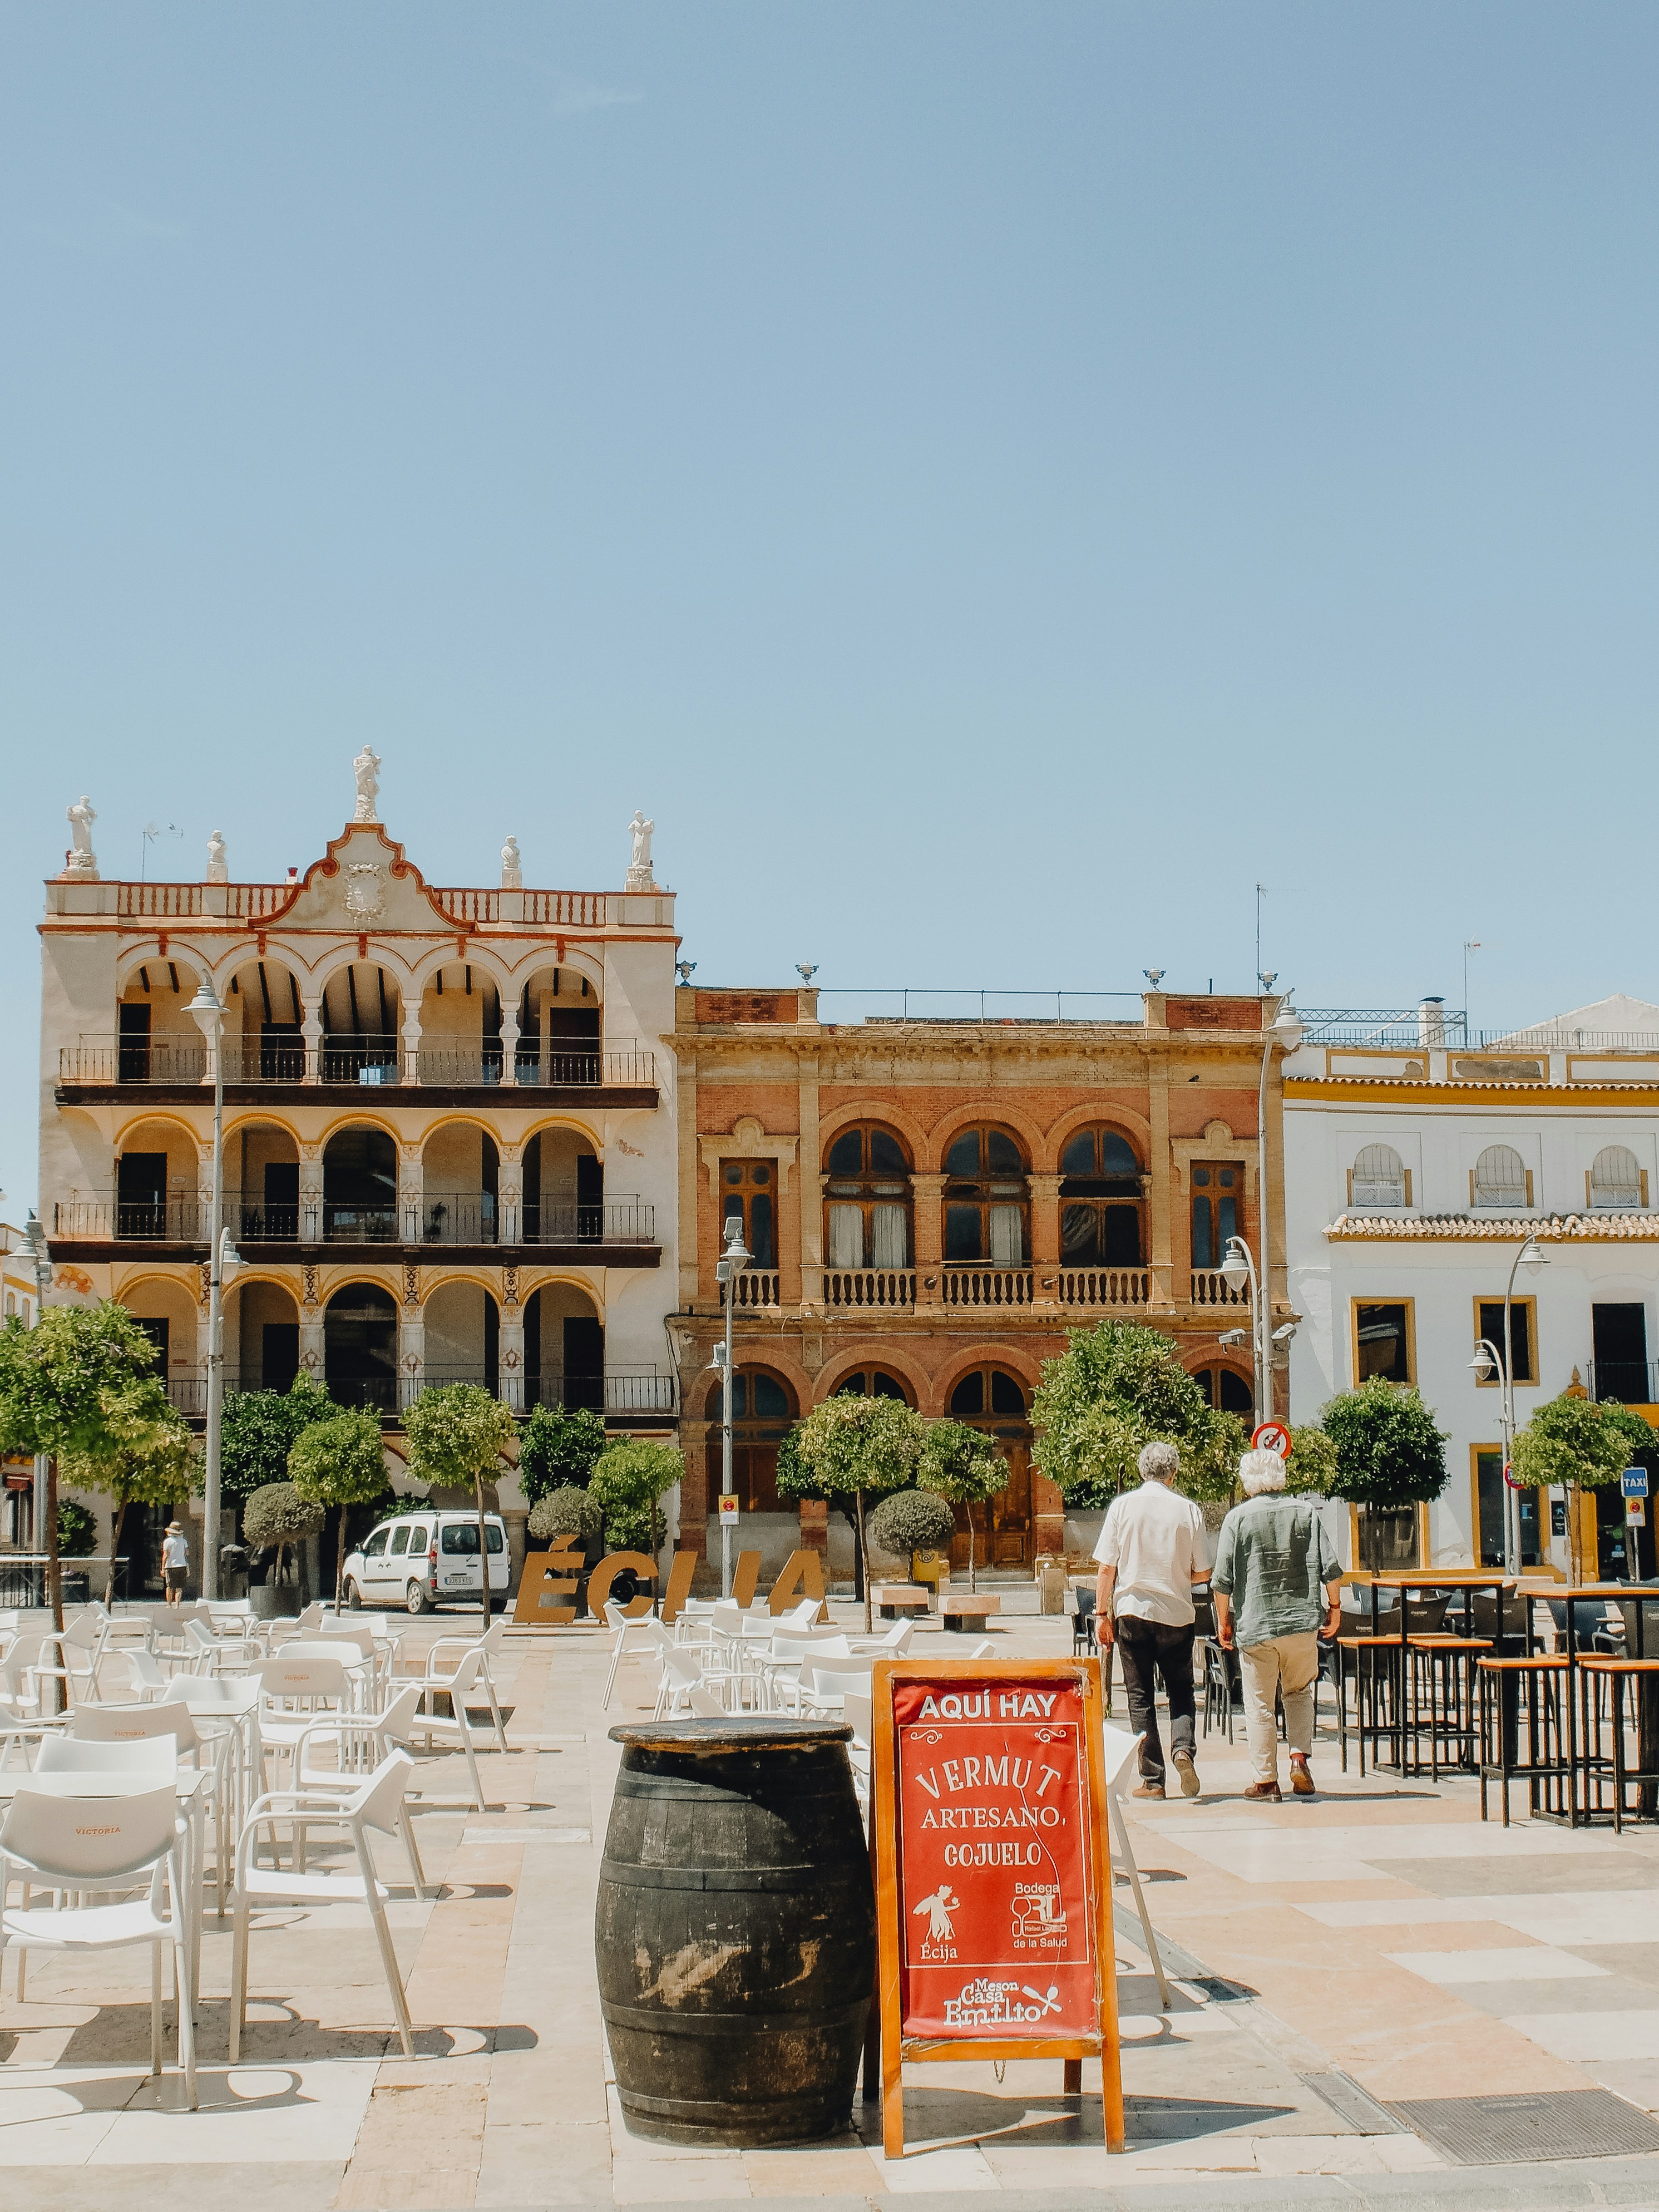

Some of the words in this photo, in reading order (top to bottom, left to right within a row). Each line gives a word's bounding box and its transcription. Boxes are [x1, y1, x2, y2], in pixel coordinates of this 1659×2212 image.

[1623, 1478, 1646, 1487] TAXI
[919, 1690, 990, 1720] AQUÍ
[1000, 1693, 1057, 1717] HAY
[915, 1755, 1061, 1799] VERMUT
[920, 1806, 1060, 1829] ARTESANO
[1015, 1882, 1060, 1895] Bodega
[920, 1942, 958, 1963] Écija
[1013, 1939, 1026, 1948] de
[1028, 1938, 1038, 1948] la
[1040, 1937, 1068, 1948] Salud
[961, 1982, 1006, 2006] Casa
[974, 1977, 1020, 1992] Meson
[943, 1996, 1041, 2028] Emilio
